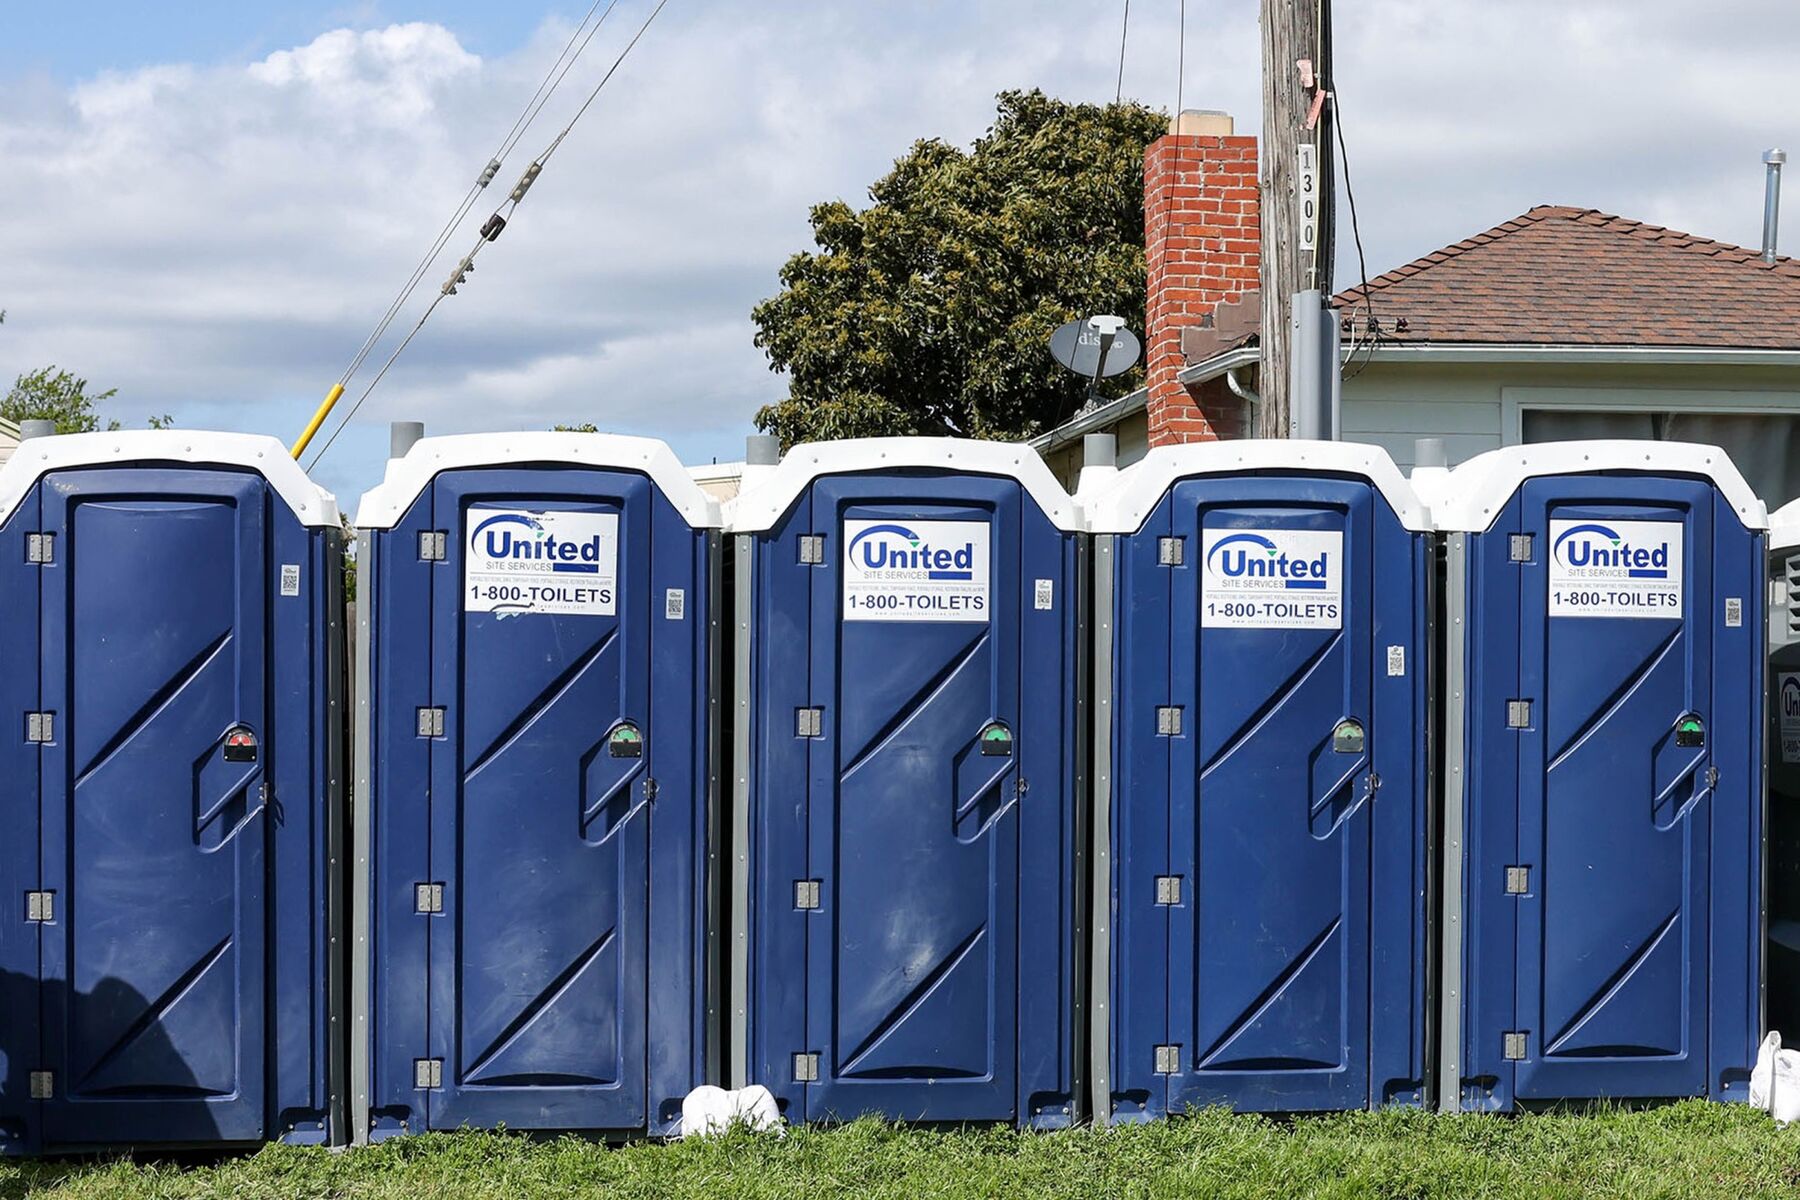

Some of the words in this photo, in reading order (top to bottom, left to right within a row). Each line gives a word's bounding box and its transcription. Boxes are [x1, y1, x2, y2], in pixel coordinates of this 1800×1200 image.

[1303, 151, 1313, 243] 1300
[486, 531, 600, 561] United
[1568, 540, 1668, 568] United
[863, 541, 973, 569] United
[486, 561, 505, 570] SITE
[507, 562, 552, 572] SERVICES
[1222, 550, 1327, 578] United
[864, 571, 883, 580] SITE
[885, 571, 928, 580] SERVICES
[1568, 569, 1588, 577] SITE
[1589, 569, 1628, 578] SERVICES
[1222, 579, 1241, 588] SITE
[1242, 580, 1284, 588] SERVICES
[470, 585, 612, 604] 1-800-TOILETS
[848, 594, 984, 610] 1-800-TOILETS
[1553, 591, 1678, 607] 1-800-TOILETS
[1207, 602, 1338, 618] 1-800-TOILETS
